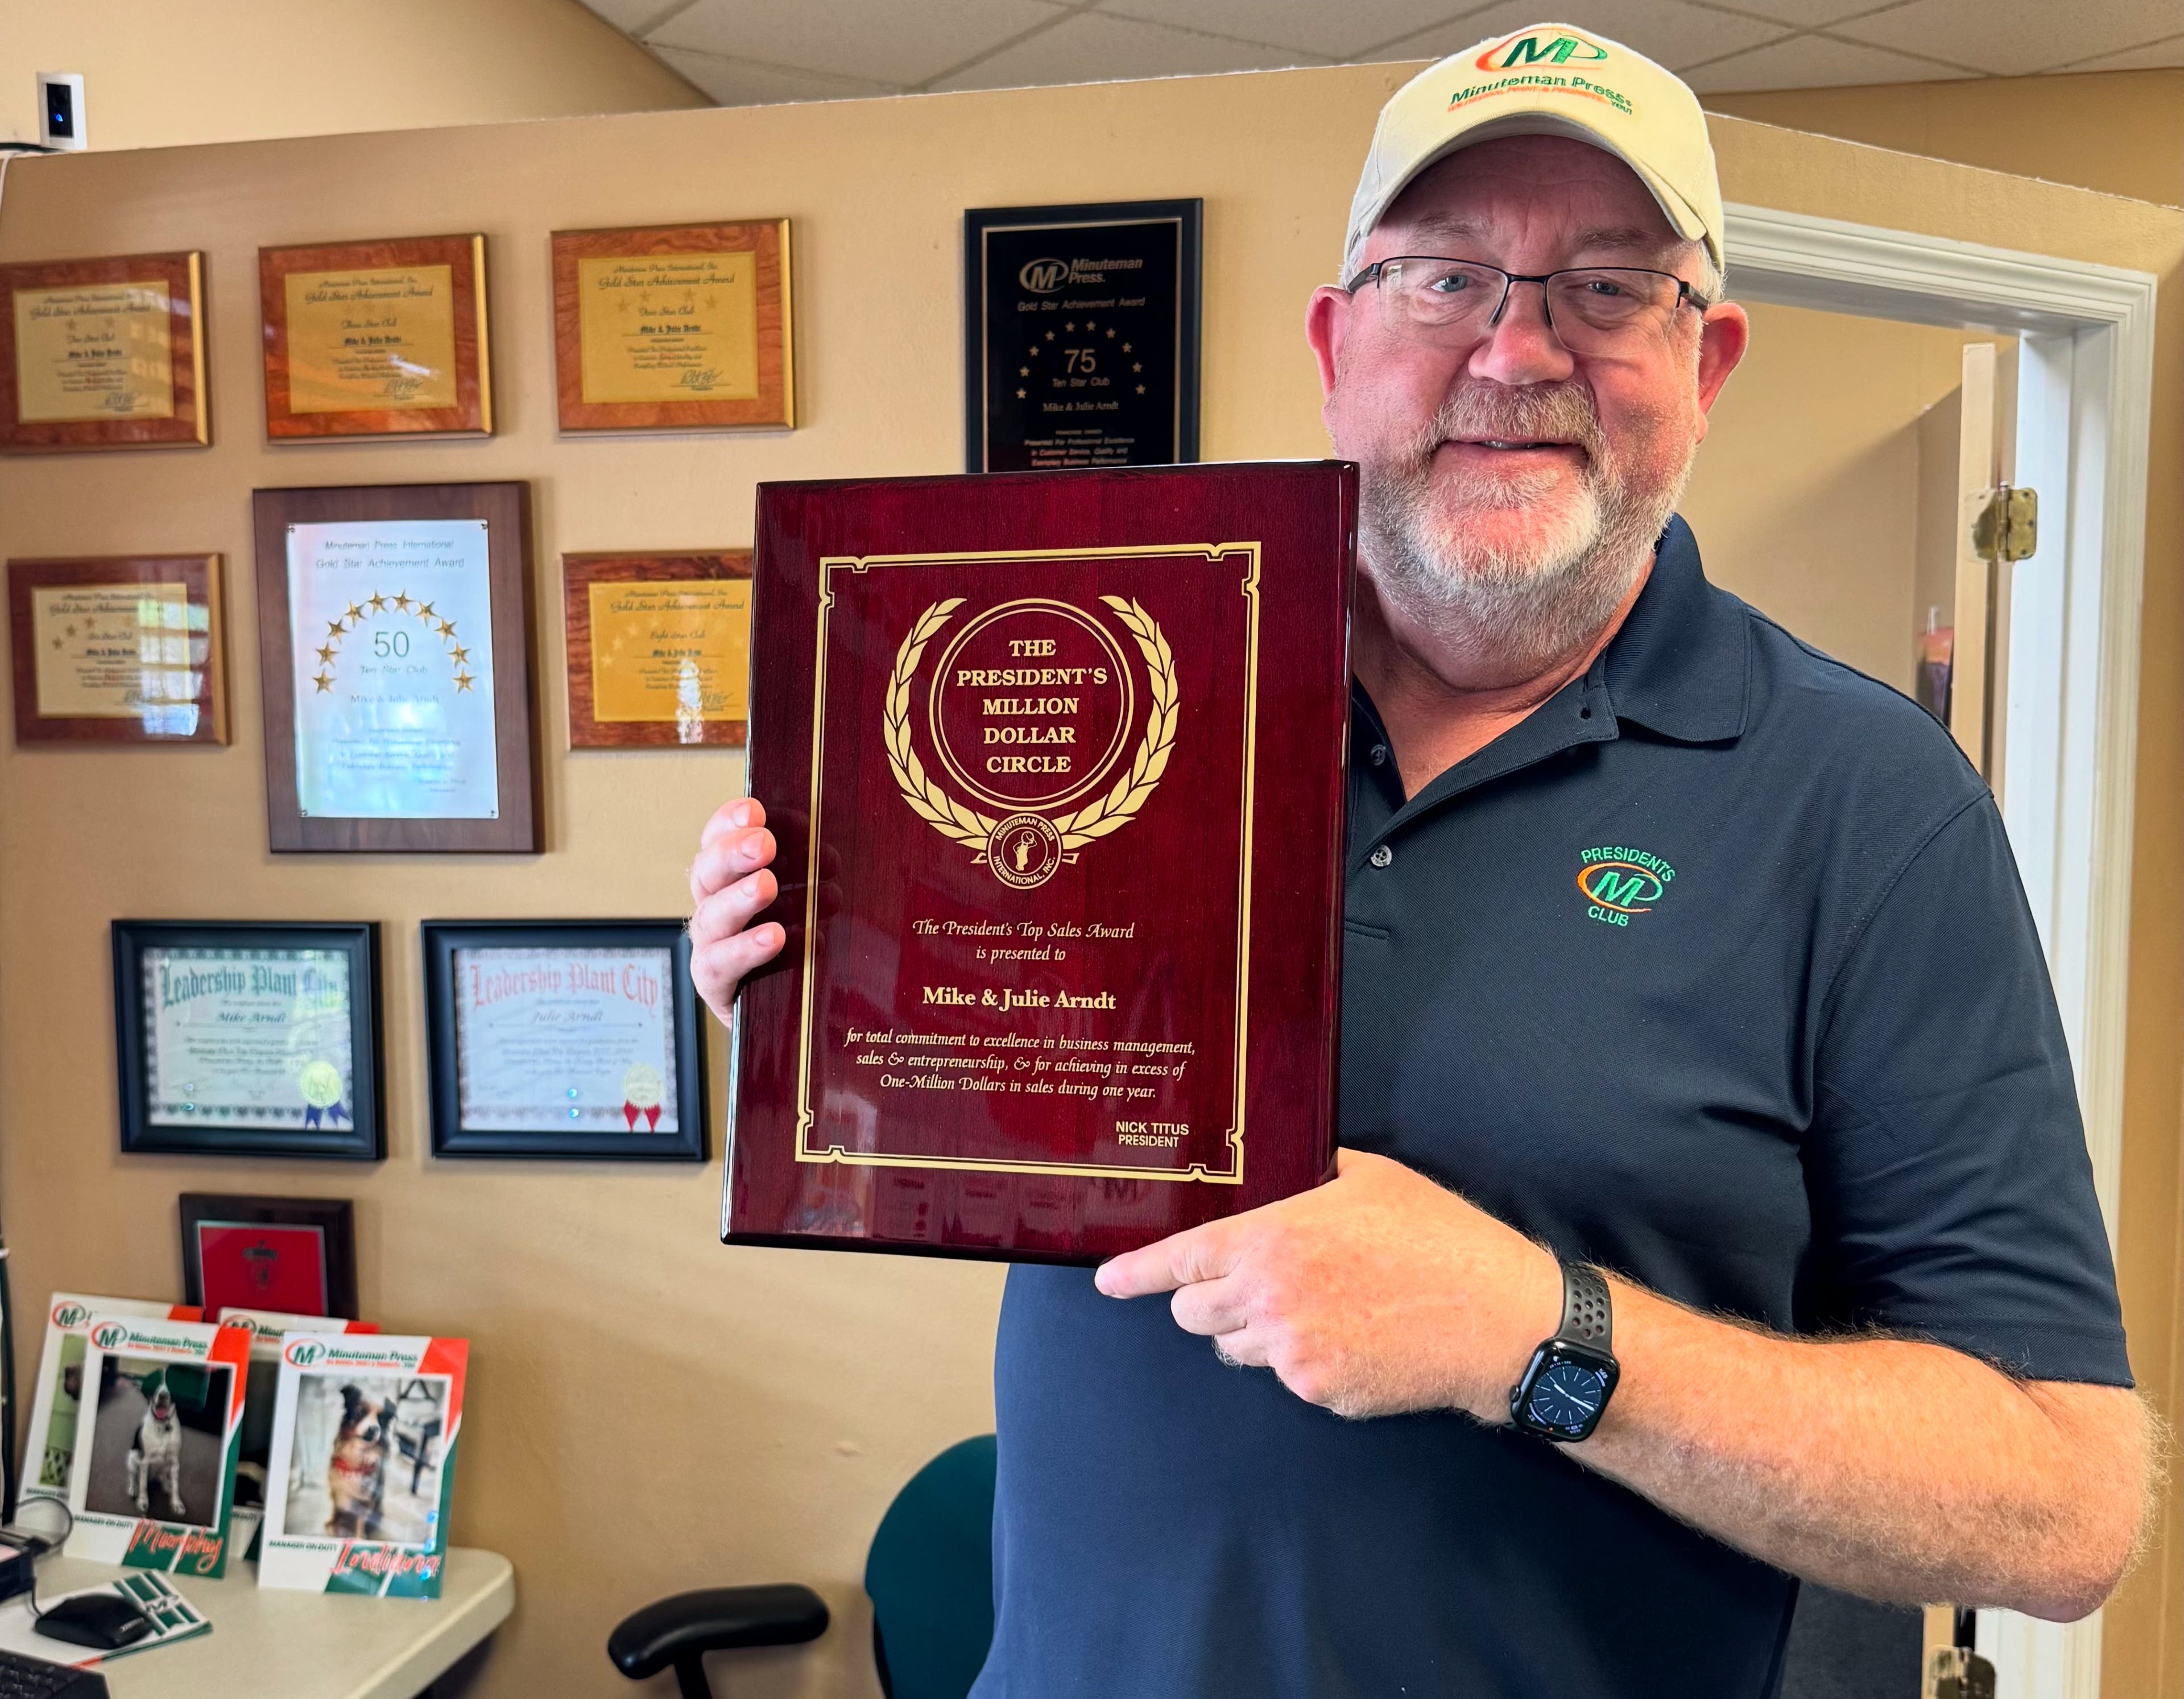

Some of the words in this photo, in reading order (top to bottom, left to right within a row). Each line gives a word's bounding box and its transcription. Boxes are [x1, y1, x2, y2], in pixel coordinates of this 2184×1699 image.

[1450, 75, 1566, 106] Minuteman
[1071, 258, 1143, 271] Minuteman
[598, 276, 623, 290] Gold
[623, 276, 644, 287] Star
[647, 274, 700, 286] Achievement
[702, 272, 735, 284] Award
[1017, 301, 1037, 312] Gold
[1041, 301, 1059, 311] Star
[1062, 299, 1115, 310] Achievement
[1119, 297, 1145, 308] Award
[1064, 348, 1097, 374] 75
[1052, 378, 1066, 387] Ten
[1069, 378, 1087, 387] Star
[1090, 377, 1110, 386] Club
[1043, 402, 1064, 412] Mike
[1065, 402, 1073, 411] &
[1075, 401, 1095, 411] Julie
[1095, 401, 1119, 410] Arndt
[325, 541, 370, 551] Minuteman
[374, 540, 401, 549] Press
[403, 539, 454, 549] International
[316, 559, 338, 569] Gold
[344, 558, 363, 568] Star
[368, 557, 429, 569] Achievement
[434, 557, 465, 568] Award
[610, 600, 633, 613] Gold
[636, 600, 656, 611] Star
[713, 598, 744, 610] Award
[374, 631, 410, 658] 50
[1009, 640, 1056, 656] THE
[360, 665, 377, 674] Ten
[382, 665, 400, 674] Star
[406, 664, 428, 674] Club
[957, 668, 1107, 686] PRESIDENT'S
[983, 698, 1079, 714] MILLION
[984, 727, 1076, 743] DOLLAR
[987, 757, 1071, 772] CIRCLE
[995, 817, 1037, 841] MINUTEMAN
[1037, 822, 1055, 841] PRESS
[993, 855, 1045, 884] INTERNATIONAL,
[1043, 857, 1056, 874] INC.
[1581, 846, 1675, 882] PRESIDENTS
[1588, 906, 1629, 927] CLUB
[913, 919, 939, 934] The
[942, 920, 1012, 936] President's
[1017, 921, 1043, 941] Top
[1048, 922, 1081, 937] Sales
[1086, 923, 1135, 938] Award
[977, 946, 986, 958] is
[991, 945, 1050, 964] presented
[1055, 949, 1065, 960] to
[159, 962, 246, 1007] Leadership
[251, 964, 297, 996] Plant
[470, 962, 561, 1011] Leadership
[568, 962, 616, 995] Plant
[622, 962, 658, 1017] City
[923, 987, 976, 1005] Mike
[982, 989, 998, 1006] &
[999, 989, 1050, 1011] Julie
[1054, 990, 1116, 1009] Arndt
[844, 1027, 863, 1047] for
[866, 1028, 893, 1043] total
[896, 1030, 966, 1045] commitment
[970, 1035, 979, 1046] to
[984, 1032, 1040, 1048] excellence
[1044, 1036, 1054, 1048] in
[1060, 1035, 1108, 1050] business
[1114, 1042, 1194, 1057] management,
[857, 1050, 883, 1064] sales
[888, 1053, 904, 1065] &
[908, 1054, 1008, 1074] entrepreneurship,
[1014, 1057, 1030, 1070] &
[1032, 1057, 1052, 1076] for
[1055, 1057, 1111, 1078] achieving
[1116, 1061, 1127, 1073] in
[1132, 1065, 1168, 1075] excess
[1173, 1061, 1187, 1081] of
[880, 1074, 954, 1089] One-Million
[959, 1076, 1006, 1091] Dollars
[1010, 1080, 1021, 1092] in
[1025, 1078, 1053, 1093] sales
[1058, 1079, 1098, 1100] during
[1103, 1087, 1123, 1096] one
[1127, 1088, 1155, 1102] year.
[1116, 1121, 1147, 1133] NICK
[1151, 1123, 1189, 1135] TITUS
[1119, 1134, 1178, 1147] PRESIDENT
